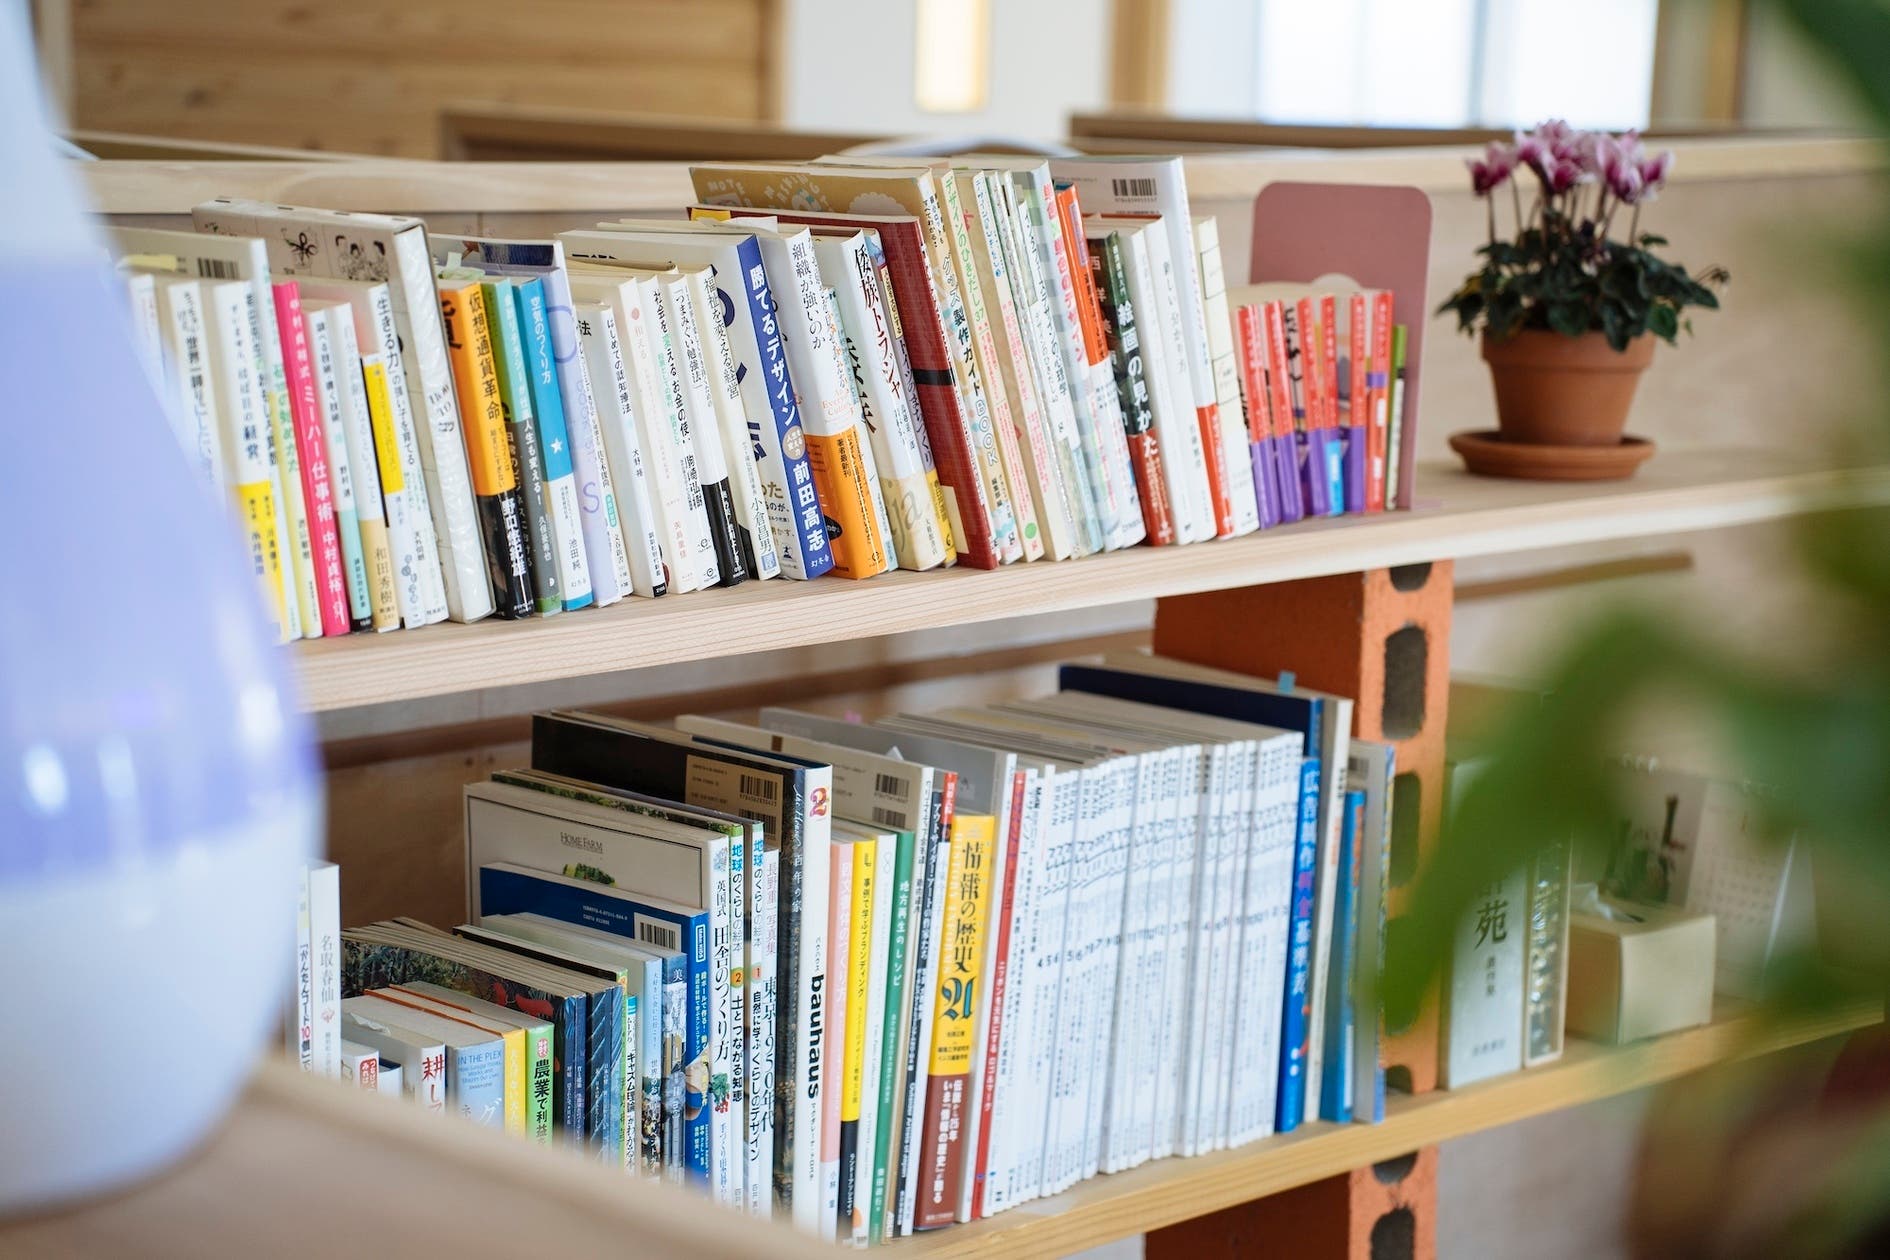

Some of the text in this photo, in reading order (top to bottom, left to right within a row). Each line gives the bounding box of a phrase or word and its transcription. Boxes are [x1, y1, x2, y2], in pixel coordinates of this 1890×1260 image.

[749, 262, 797, 427] 勝てるデザイン
[792, 243, 825, 350] 組織が強いのか
[854, 243, 902, 401] 倭族トラジャ
[468, 290, 500, 421] 仮想通貨革命
[606, 318, 632, 415] はじめての認知療法
[1117, 299, 1158, 457] 絵画の見かた
[303, 385, 333, 523] ミーハー仕事術
[792, 460, 826, 553] 前田高志
[375, 547, 394, 604] 和田秀樹
[560, 831, 582, 847] HOME
[809, 786, 827, 818] 2
[731, 844, 744, 952] 地球のくらしの絵本
[954, 841, 984, 974] 情報の歴史
[1474, 899, 1509, 951] 苑
[714, 926, 730, 1064] 田舎のつくり方
[731, 995, 744, 1103] 土とつながる知恵
[807, 973, 826, 1100] bauhaus
[469, 1053, 483, 1063] THE
[763, 976, 777, 1133] 東京1950年代
